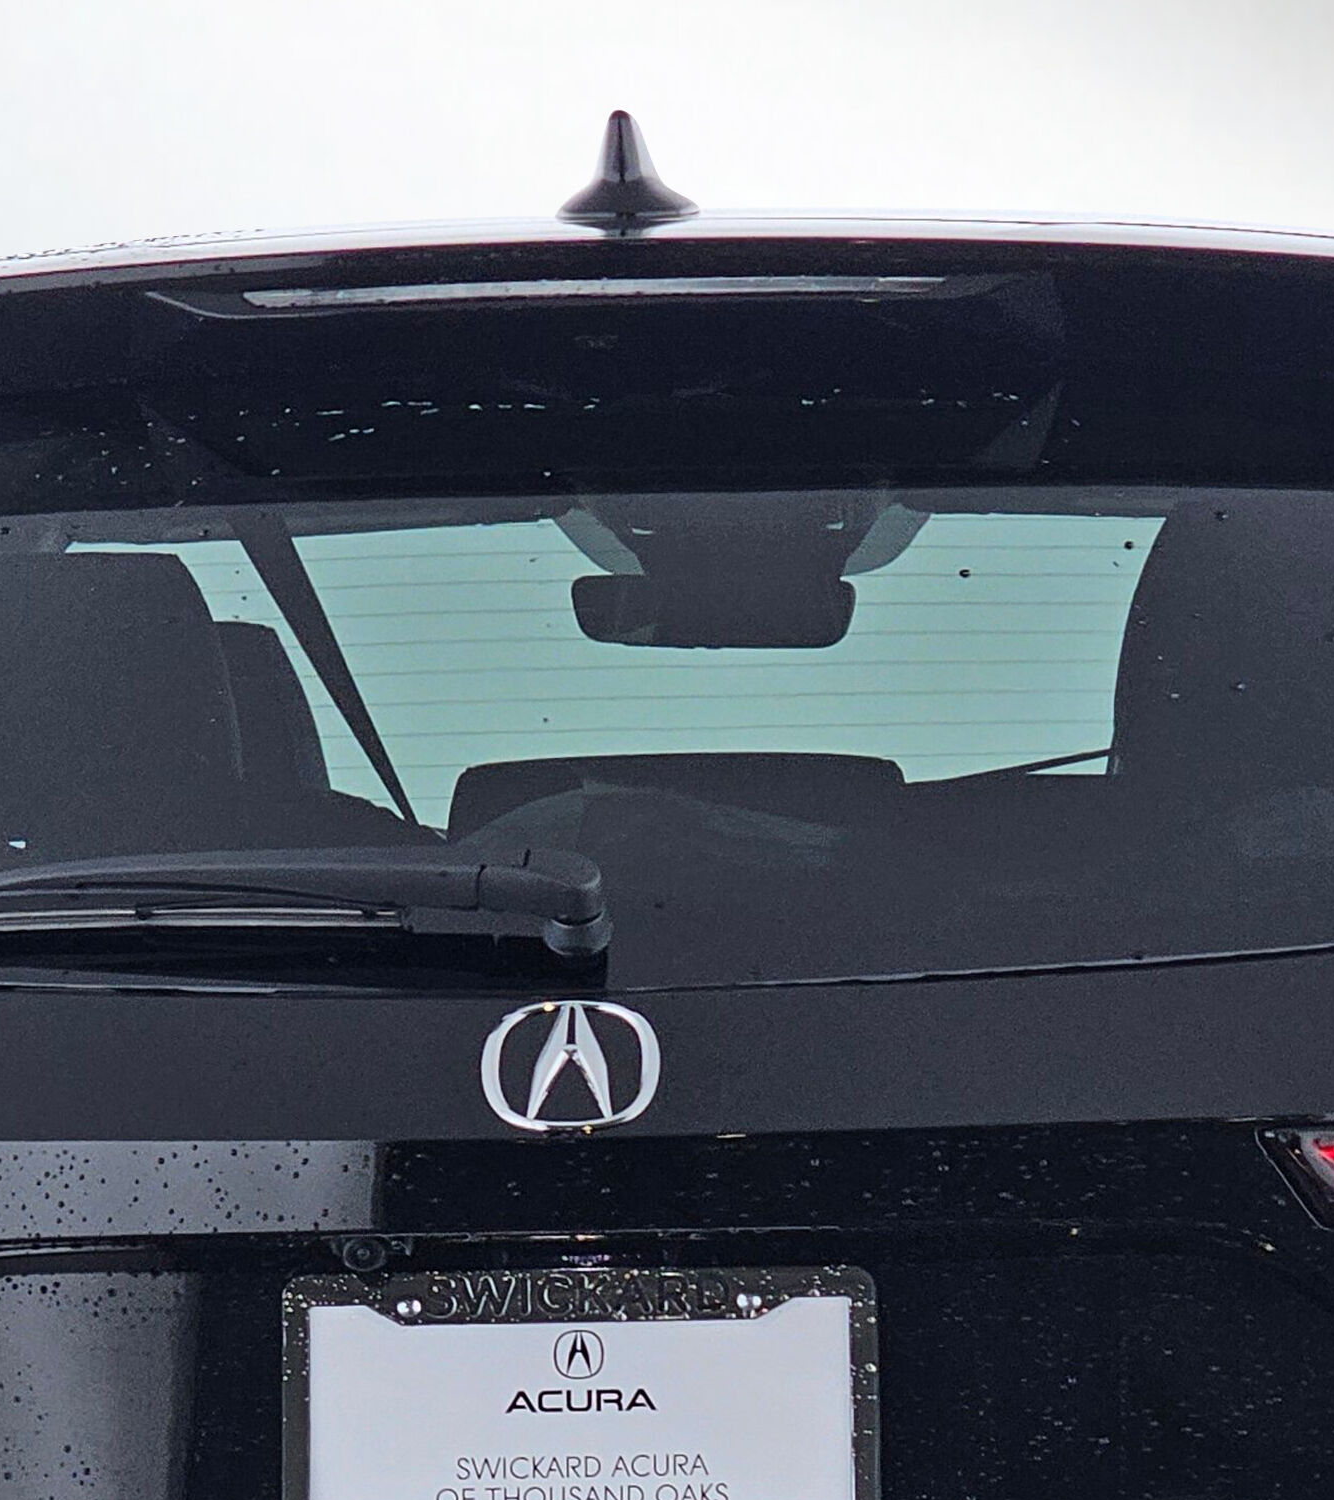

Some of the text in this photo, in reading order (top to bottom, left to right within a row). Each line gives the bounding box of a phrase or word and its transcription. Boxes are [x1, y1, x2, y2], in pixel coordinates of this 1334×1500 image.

[424, 1272, 730, 1319] SWICKARD
[505, 1388, 658, 1414] ACURA
[456, 1453, 710, 1480] SWICKARD ACURA
